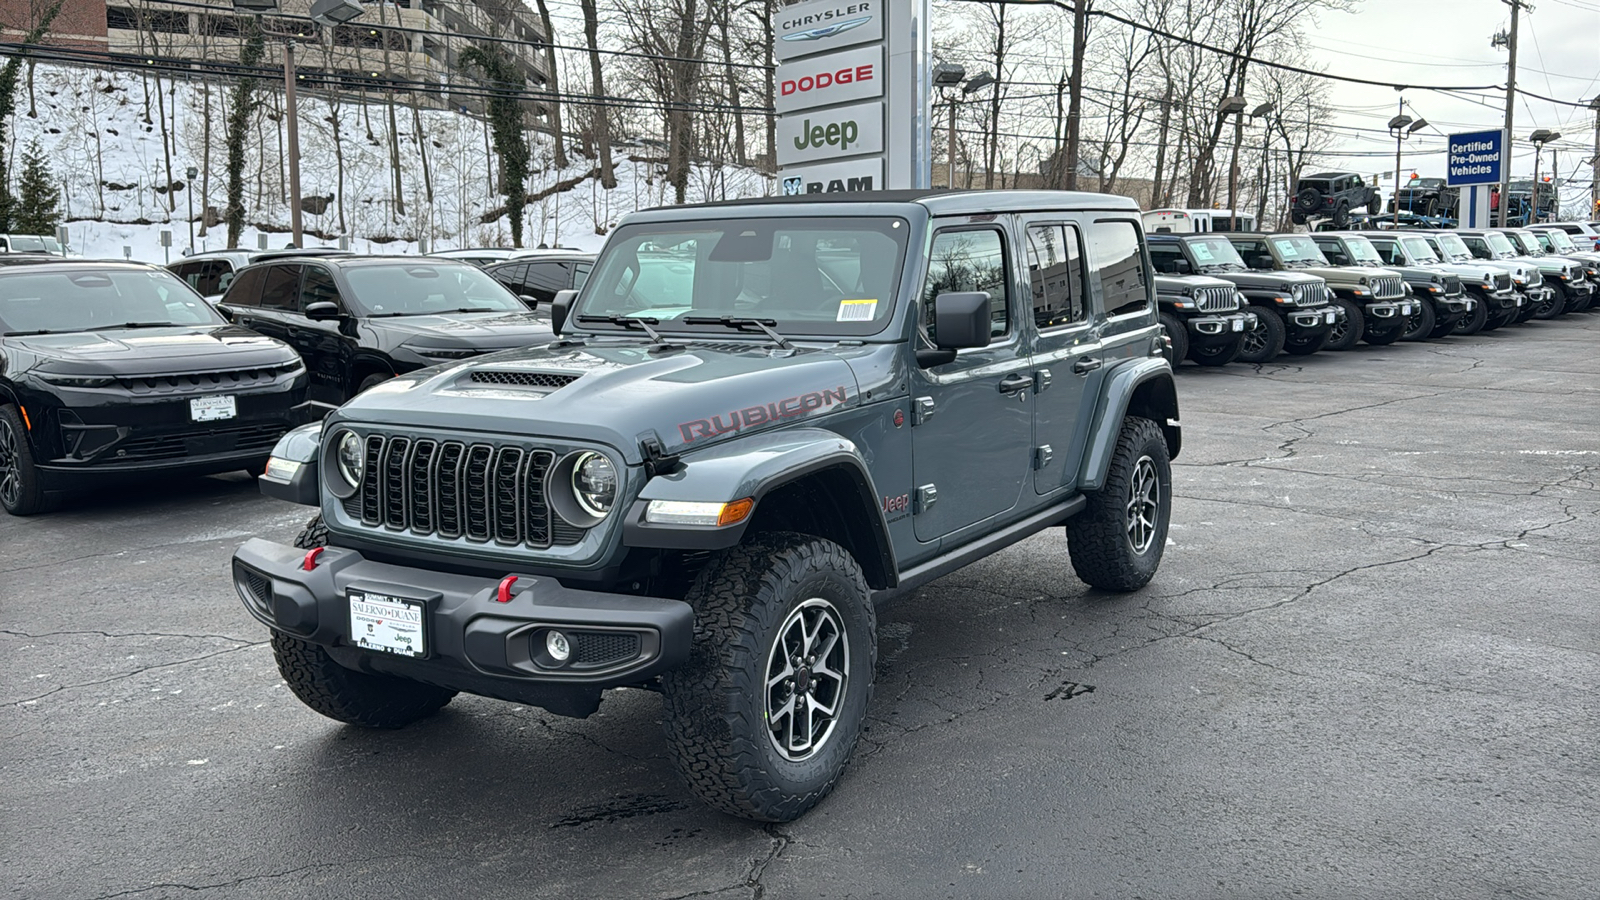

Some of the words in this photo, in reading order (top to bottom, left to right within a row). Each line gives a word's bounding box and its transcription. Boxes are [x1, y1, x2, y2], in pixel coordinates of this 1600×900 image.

[783, 3, 870, 30] CHRYSLER
[781, 64, 873, 96] DODGE
[794, 119, 858, 150] Jeep
[1451, 141, 1492, 153] Certified
[1451, 152, 1498, 164] Pre-Owned
[1451, 165, 1492, 176] Vehicles
[806, 176, 873, 194] RAM
[678, 386, 848, 443] RUBICON
[883, 493, 909, 513] Jeep
[352, 602, 387, 616] SALERNO
[391, 609, 420, 622] DUANE
[394, 633, 412, 644] Jeep
